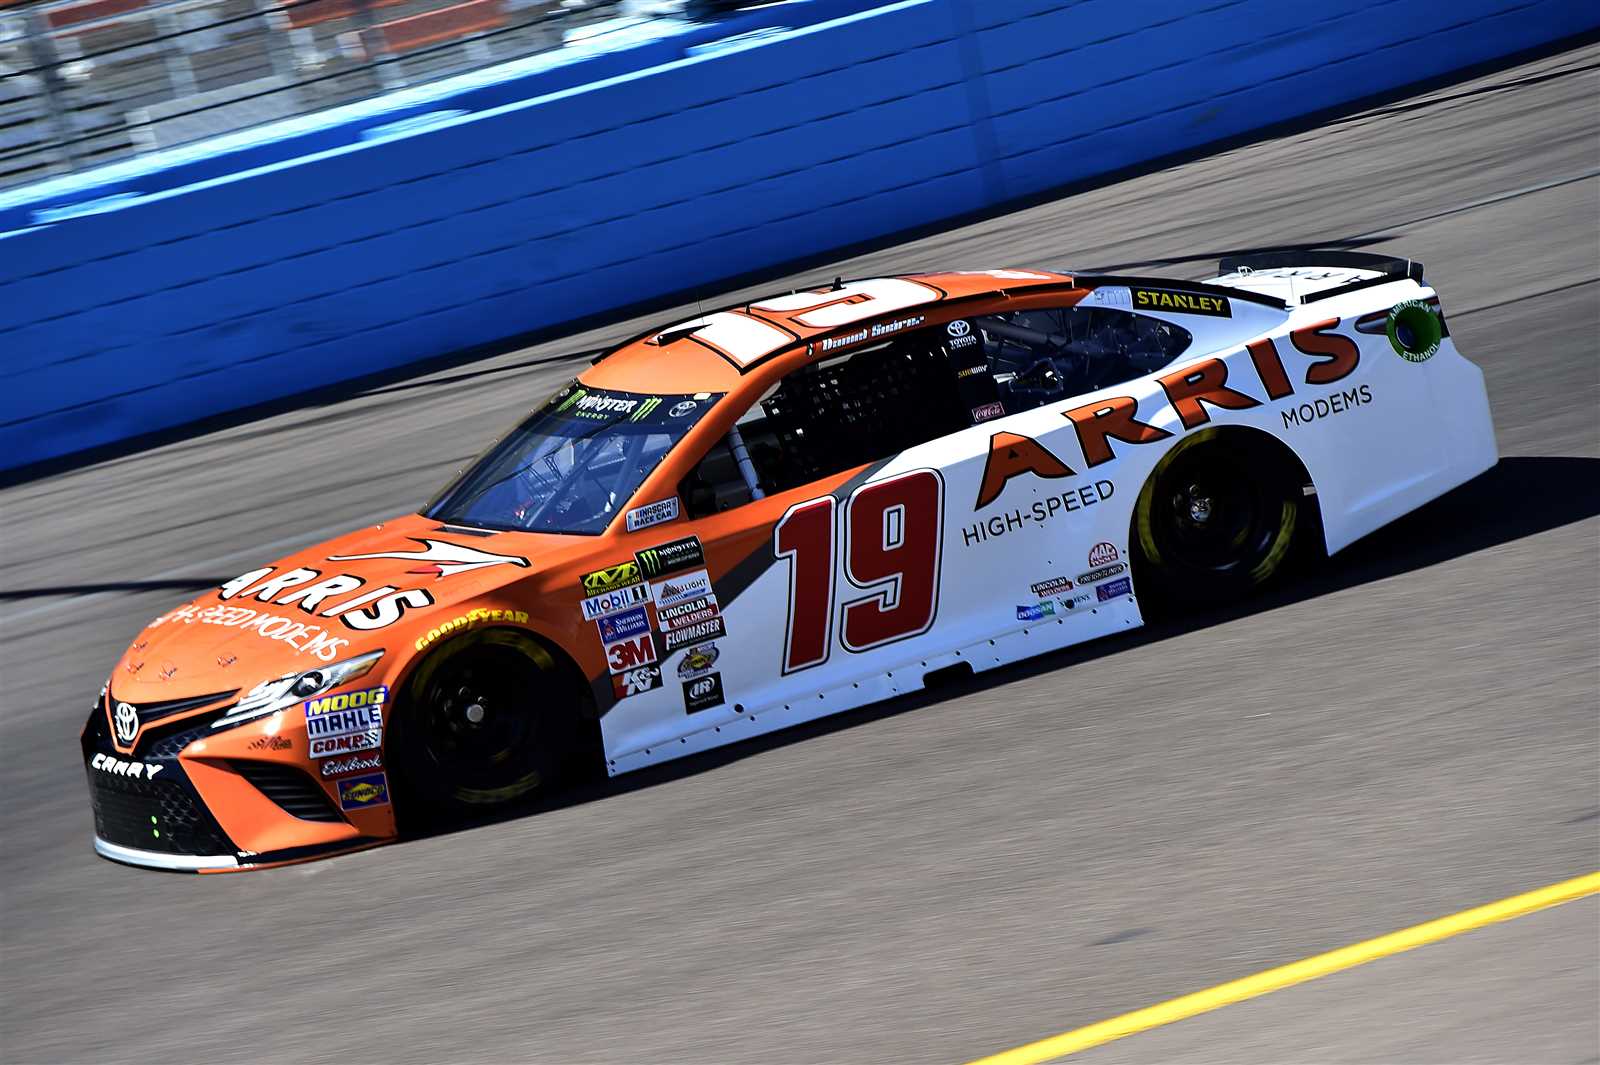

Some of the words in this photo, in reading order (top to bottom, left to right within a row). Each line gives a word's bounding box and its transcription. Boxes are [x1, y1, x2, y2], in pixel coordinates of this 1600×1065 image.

[1137, 290, 1224, 311] STANLEY
[1389, 299, 1431, 320] AMERICAN
[948, 334, 978, 347] TOYOTA
[1402, 343, 1441, 362] ETHANOL
[575, 394, 638, 414] MONSTER
[974, 316, 1361, 512] ARRIS
[1280, 384, 1373, 430] MODEMS
[633, 515, 655, 528] RACE
[656, 510, 673, 521] CAR
[638, 501, 672, 518] NASCAR
[961, 479, 1115, 547] HIGH-SPEED
[658, 540, 698, 558] MONSTER
[772, 466, 946, 678] 19
[1031, 578, 1066, 593] LINCOLN
[219, 566, 435, 632] ARRIS
[585, 588, 630, 616] Mobil
[660, 599, 707, 622] LINCOLN
[673, 608, 714, 627] WELDERS
[414, 607, 529, 652] GOODYEAR
[665, 618, 721, 652] FLOWMASTER
[608, 636, 655, 671] 3M
[308, 687, 385, 717] MOOG
[307, 706, 381, 735] MAHLE
[91, 752, 165, 781] CAMRY
[322, 754, 382, 776] Edelbrock
[342, 784, 385, 801] SUNOCO
